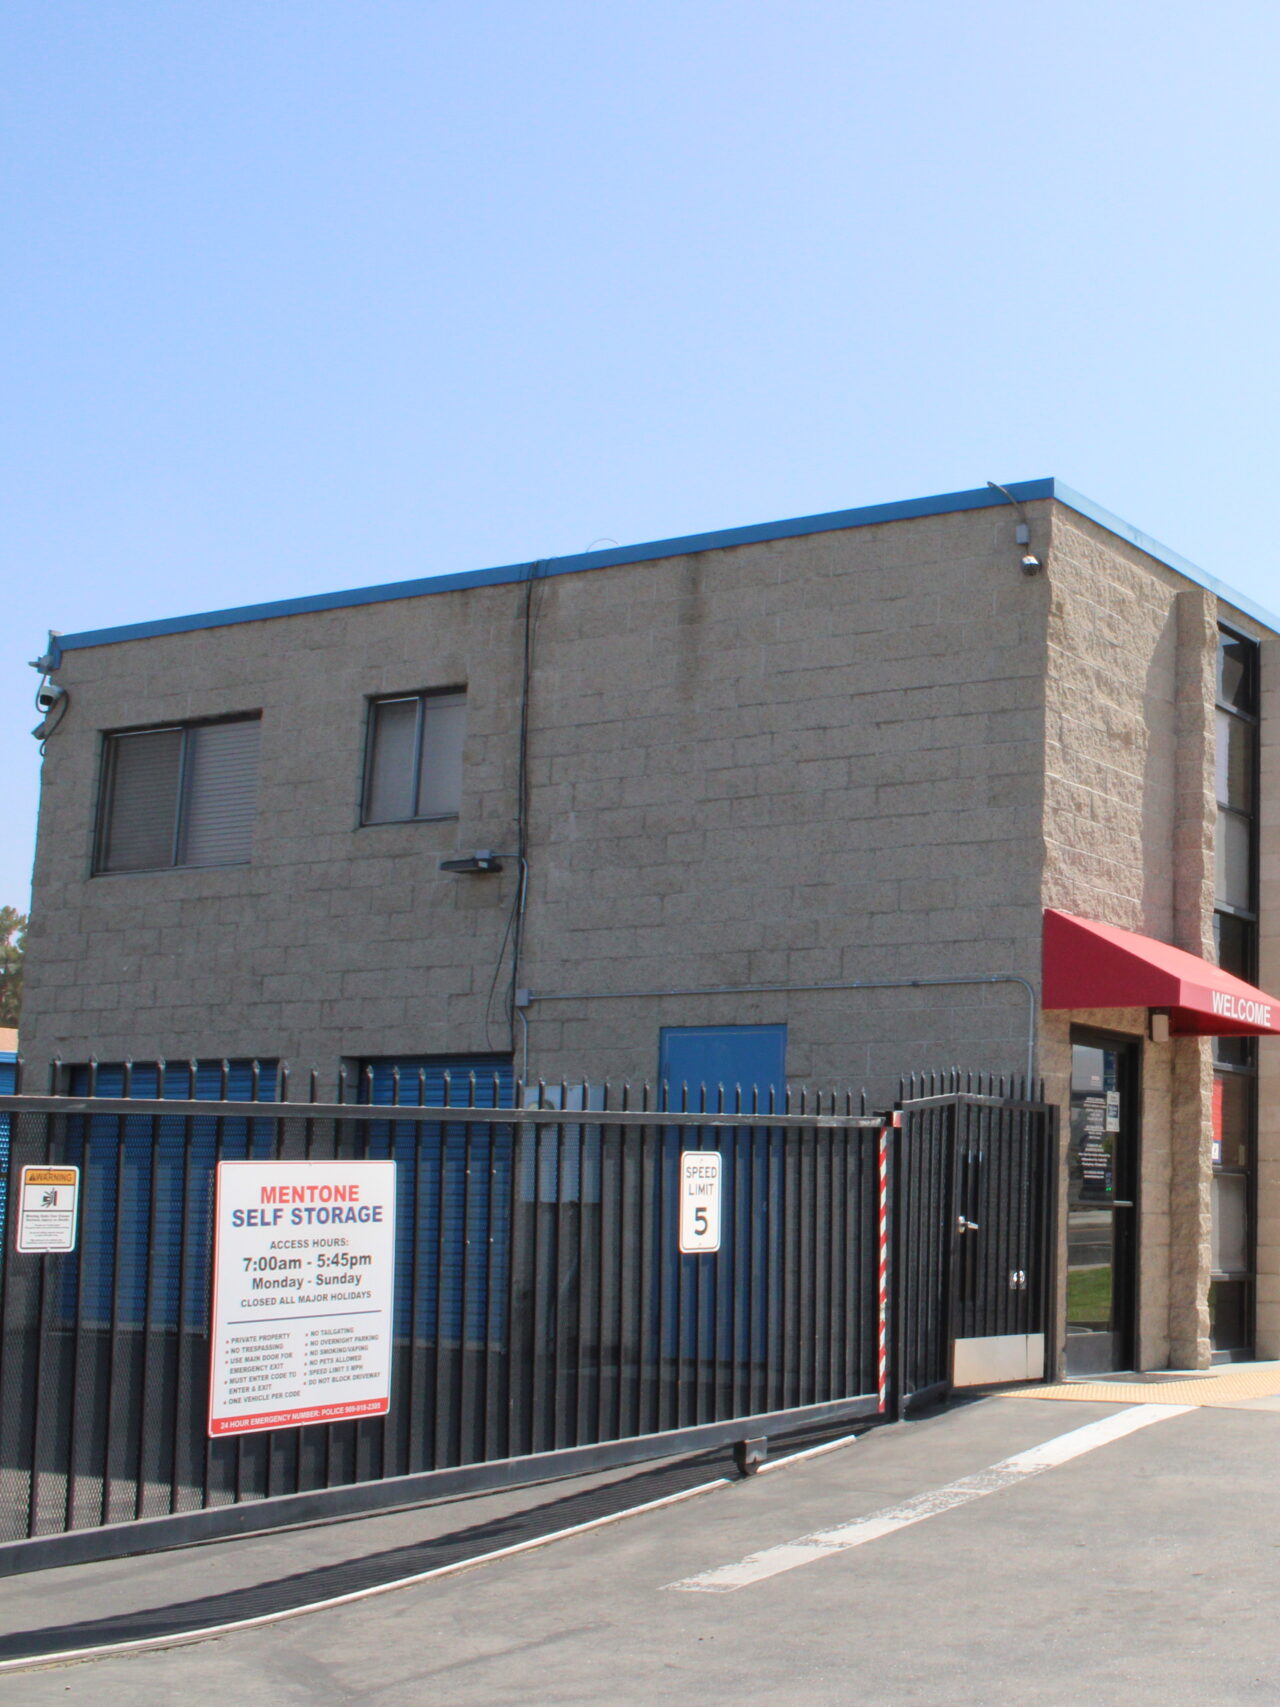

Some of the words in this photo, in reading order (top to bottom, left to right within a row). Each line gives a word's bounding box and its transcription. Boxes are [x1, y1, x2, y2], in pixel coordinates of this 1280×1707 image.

[1212, 990, 1271, 1027] WELCOME
[686, 1166, 718, 1178] SPEED
[260, 1184, 360, 1204] MENTONE
[688, 1183, 714, 1196] LIMIT
[232, 1208, 284, 1228] SELF
[290, 1205, 383, 1226] STORAGE
[694, 1207, 708, 1236] 5
[270, 1240, 310, 1250] ACCESS
[312, 1238, 350, 1248] HOURS:
[242, 1256, 302, 1272] 7:00am
[316, 1253, 372, 1270] 5:45pm
[252, 1274, 304, 1291] Monday
[315, 1273, 362, 1288] Sunday
[240, 1297, 277, 1308] CLOSED
[279, 1295, 296, 1305] ALL
[298, 1293, 329, 1304] MAJOR
[330, 1290, 372, 1302] HOLIDAYS
[320, 1327, 354, 1336] TAILGATING
[231, 1336, 257, 1344] PRIVATE
[259, 1333, 291, 1341] PROPERTY
[320, 1337, 354, 1346] OVERNIGHT
[354, 1334, 379, 1342] PARKING
[242, 1343, 284, 1353] TRESPASSING
[335, 1355, 362, 1363] ALLOWED
[230, 1364, 268, 1374] EMERGENCY
[309, 1368, 327, 1376] SPEED
[249, 1374, 269, 1382] ENTER
[270, 1372, 287, 1380] CODE
[331, 1375, 351, 1383] BLOCK
[352, 1371, 381, 1380] DRIVEWAY
[229, 1386, 250, 1395] ENTER
[244, 1394, 270, 1403] VEHICLE
[284, 1390, 301, 1398] CODE
[220, 1421, 229, 1430] 24
[230, 1418, 250, 1428] HOUR
[250, 1413, 291, 1426] EMERGENCY
[291, 1410, 320, 1420] NUMBER:
[321, 1406, 345, 1416] POLICE
